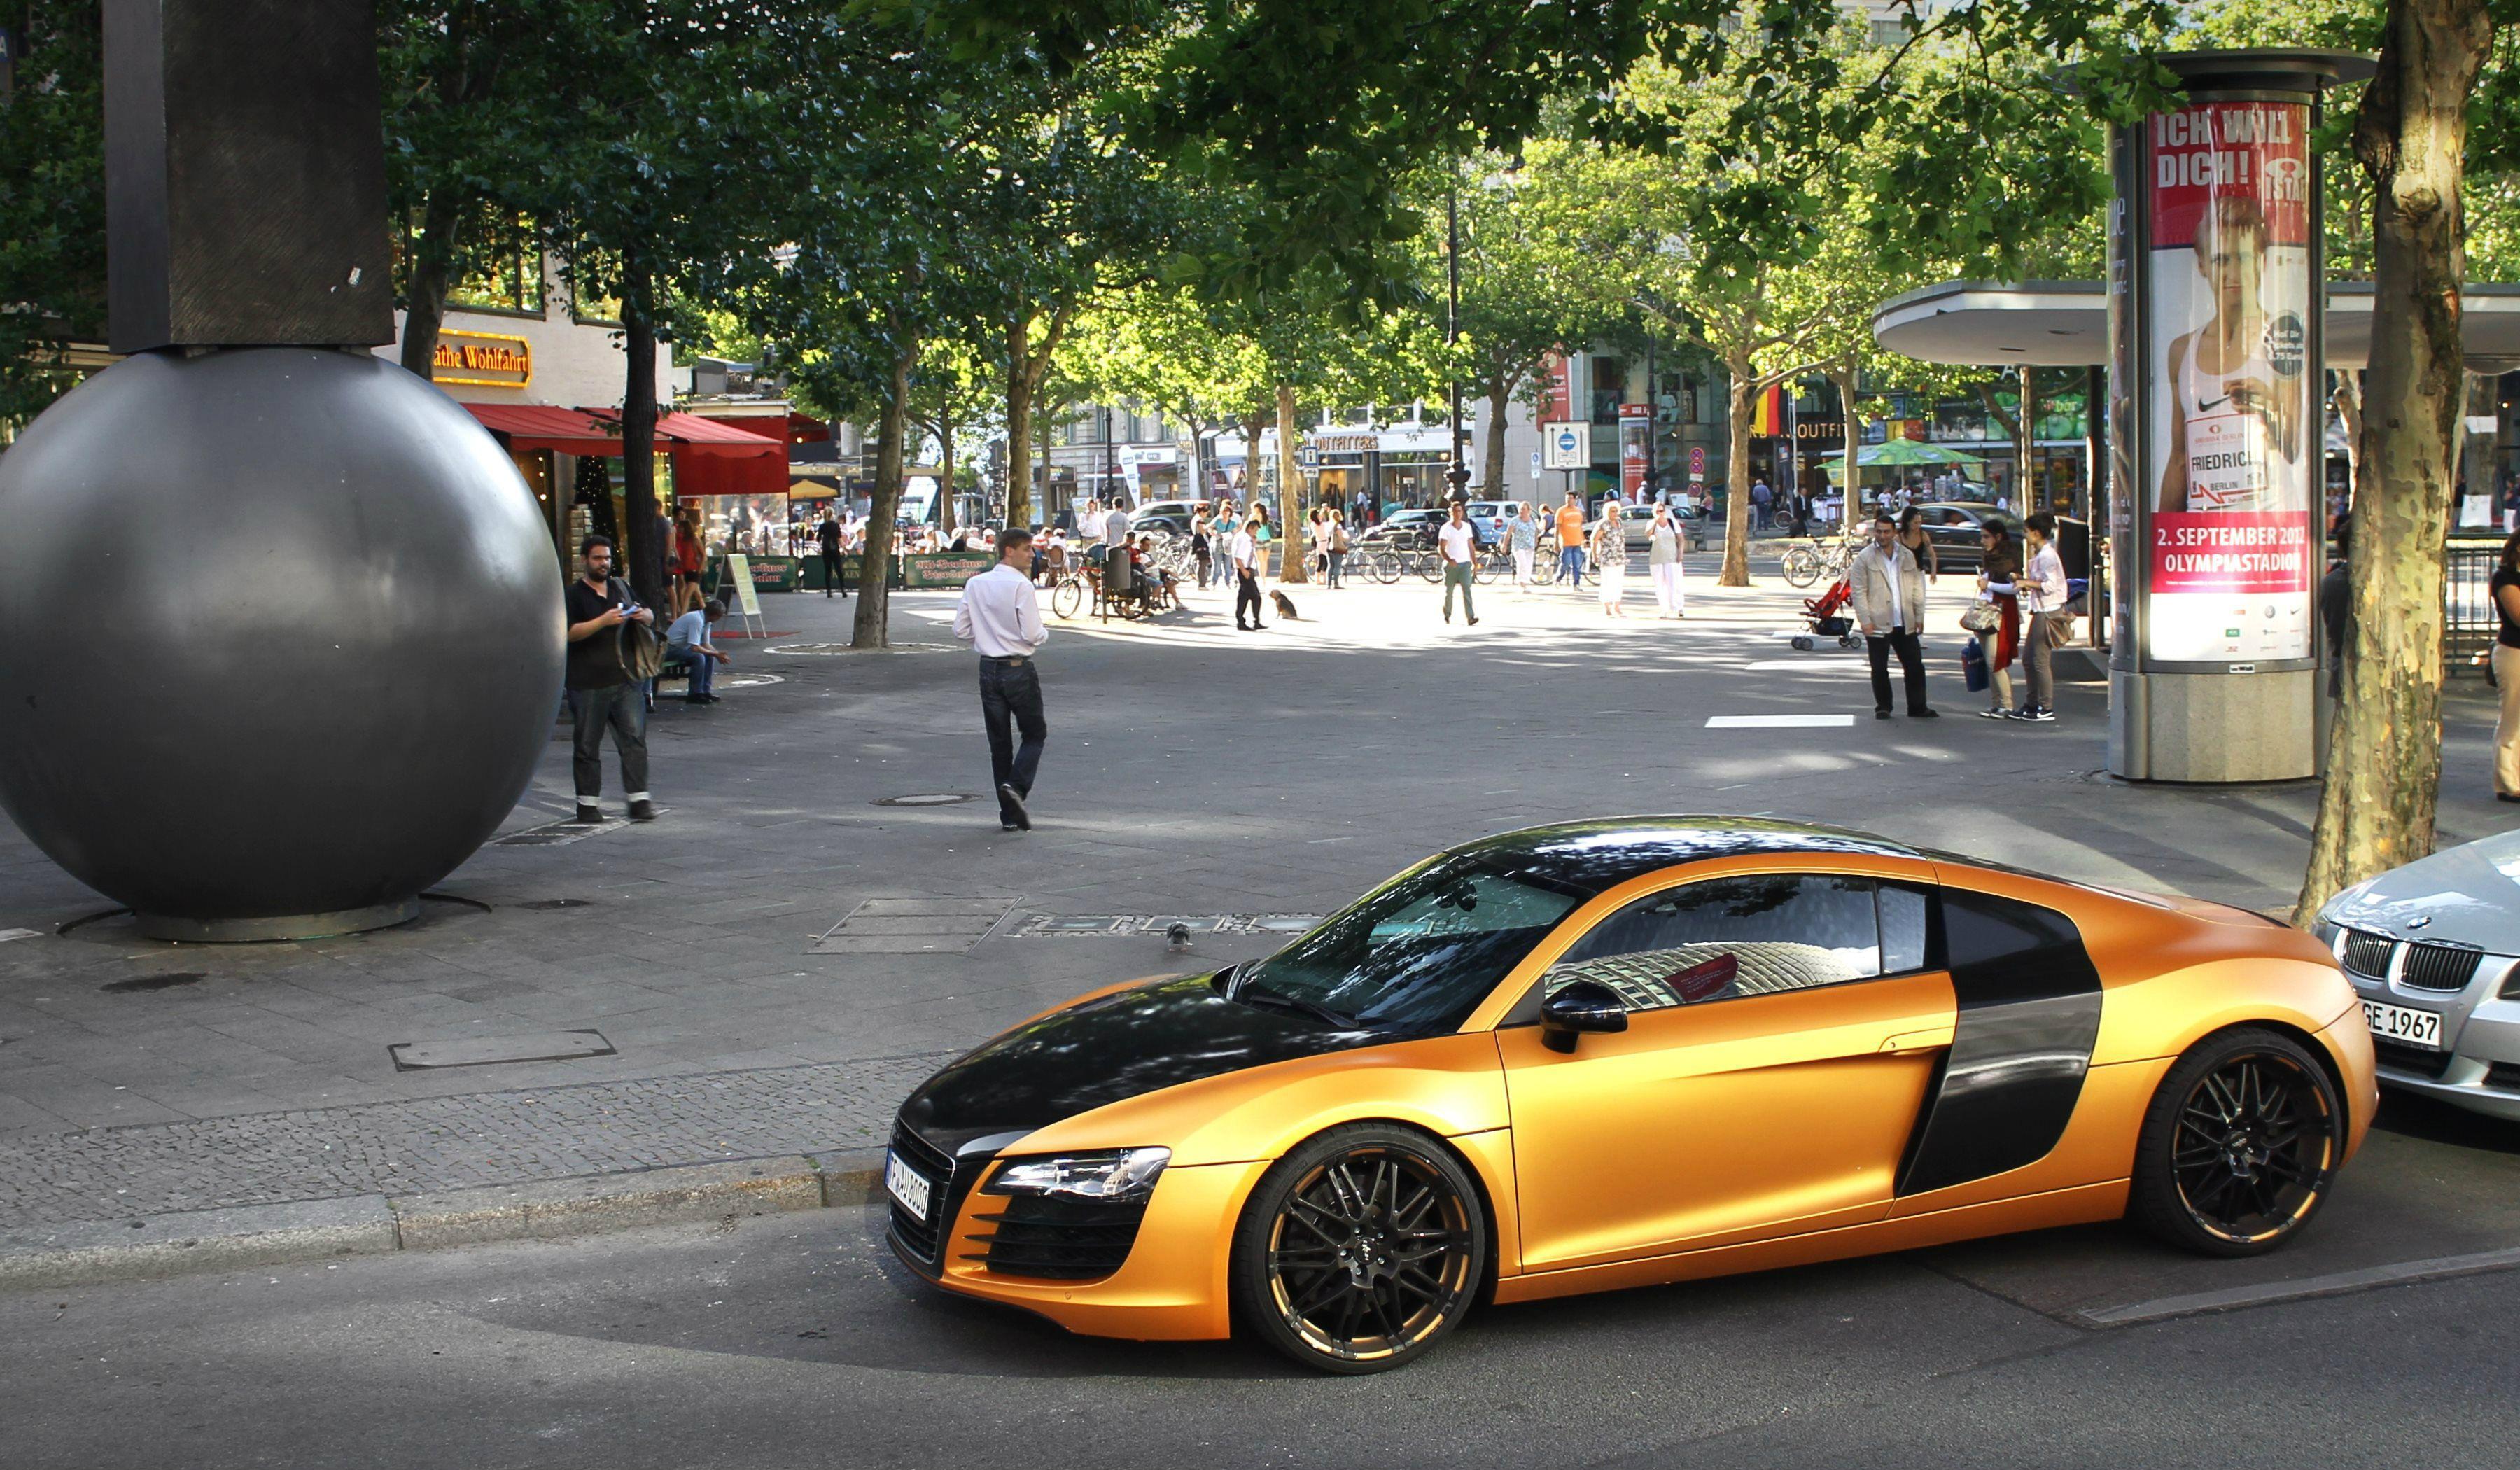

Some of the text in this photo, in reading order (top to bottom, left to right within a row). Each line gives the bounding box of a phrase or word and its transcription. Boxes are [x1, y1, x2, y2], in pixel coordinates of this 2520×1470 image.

[2157, 109, 2292, 148] ICH WILL
[2158, 150, 2249, 188] DICH!
[433, 344, 527, 372] äthe Wohlfahrt
[1313, 435, 1379, 451] OUTFITTERS
[2210, 481, 2239, 491] BERLIN
[2157, 528, 2172, 546] 2.
[2176, 527, 2276, 546] SEPTEMBER
[2165, 552, 2301, 572] OLYMPIASTADION
[2388, 1009, 2437, 1041] 1967
